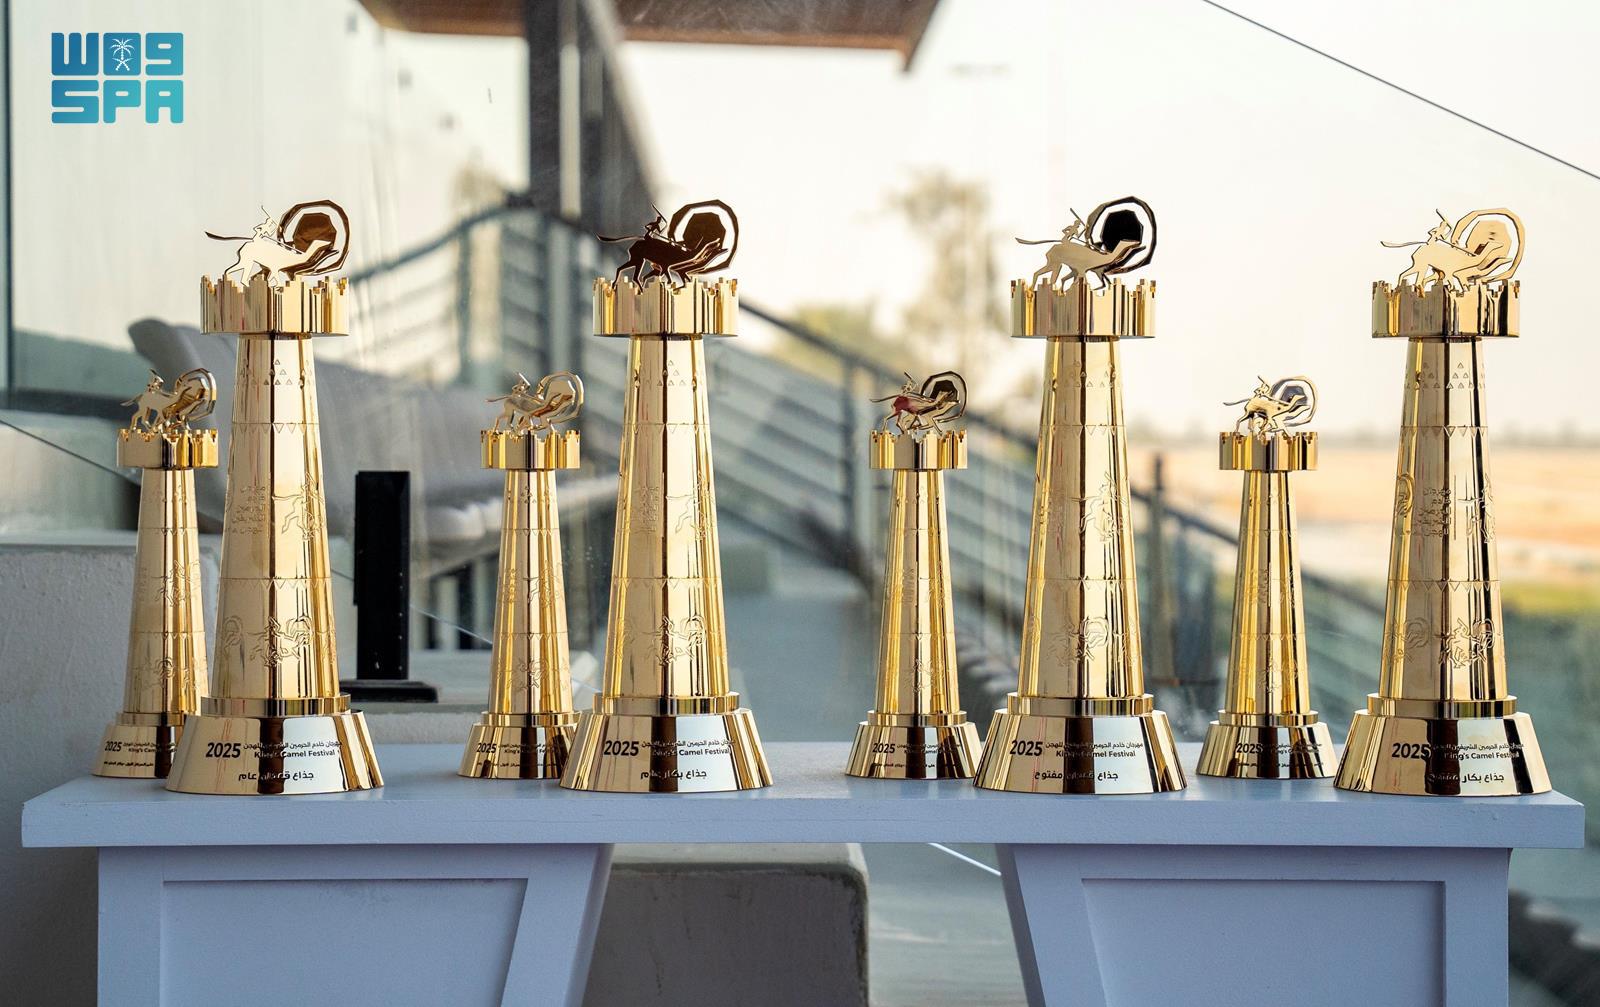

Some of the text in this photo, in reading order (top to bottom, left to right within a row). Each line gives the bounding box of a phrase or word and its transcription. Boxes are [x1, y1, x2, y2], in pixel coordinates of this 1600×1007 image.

[105, 741, 122, 752] 2025
[205, 742, 242, 759] 2025
[477, 743, 497, 753] 2025
[603, 740, 640, 757] 2025
[873, 743, 895, 753] 2025
[1009, 740, 1044, 757] 2025
[1236, 743, 1263, 754] 2025
[1391, 743, 1431, 760] 2025
[281, 750, 307, 758] Camel
[308, 749, 336, 757] Festival
[704, 748, 731, 756] Festival
[1108, 750, 1136, 758] Festival
[238, 771, 257, 781] عام
[292, 770, 314, 781] جذاع
[685, 769, 707, 780] جذاع
[1034, 770, 1063, 780] مفتوح
[1097, 771, 1118, 781] جذاع
[1462, 773, 1482, 783] بكار
[1484, 772, 1504, 783] جذاع
